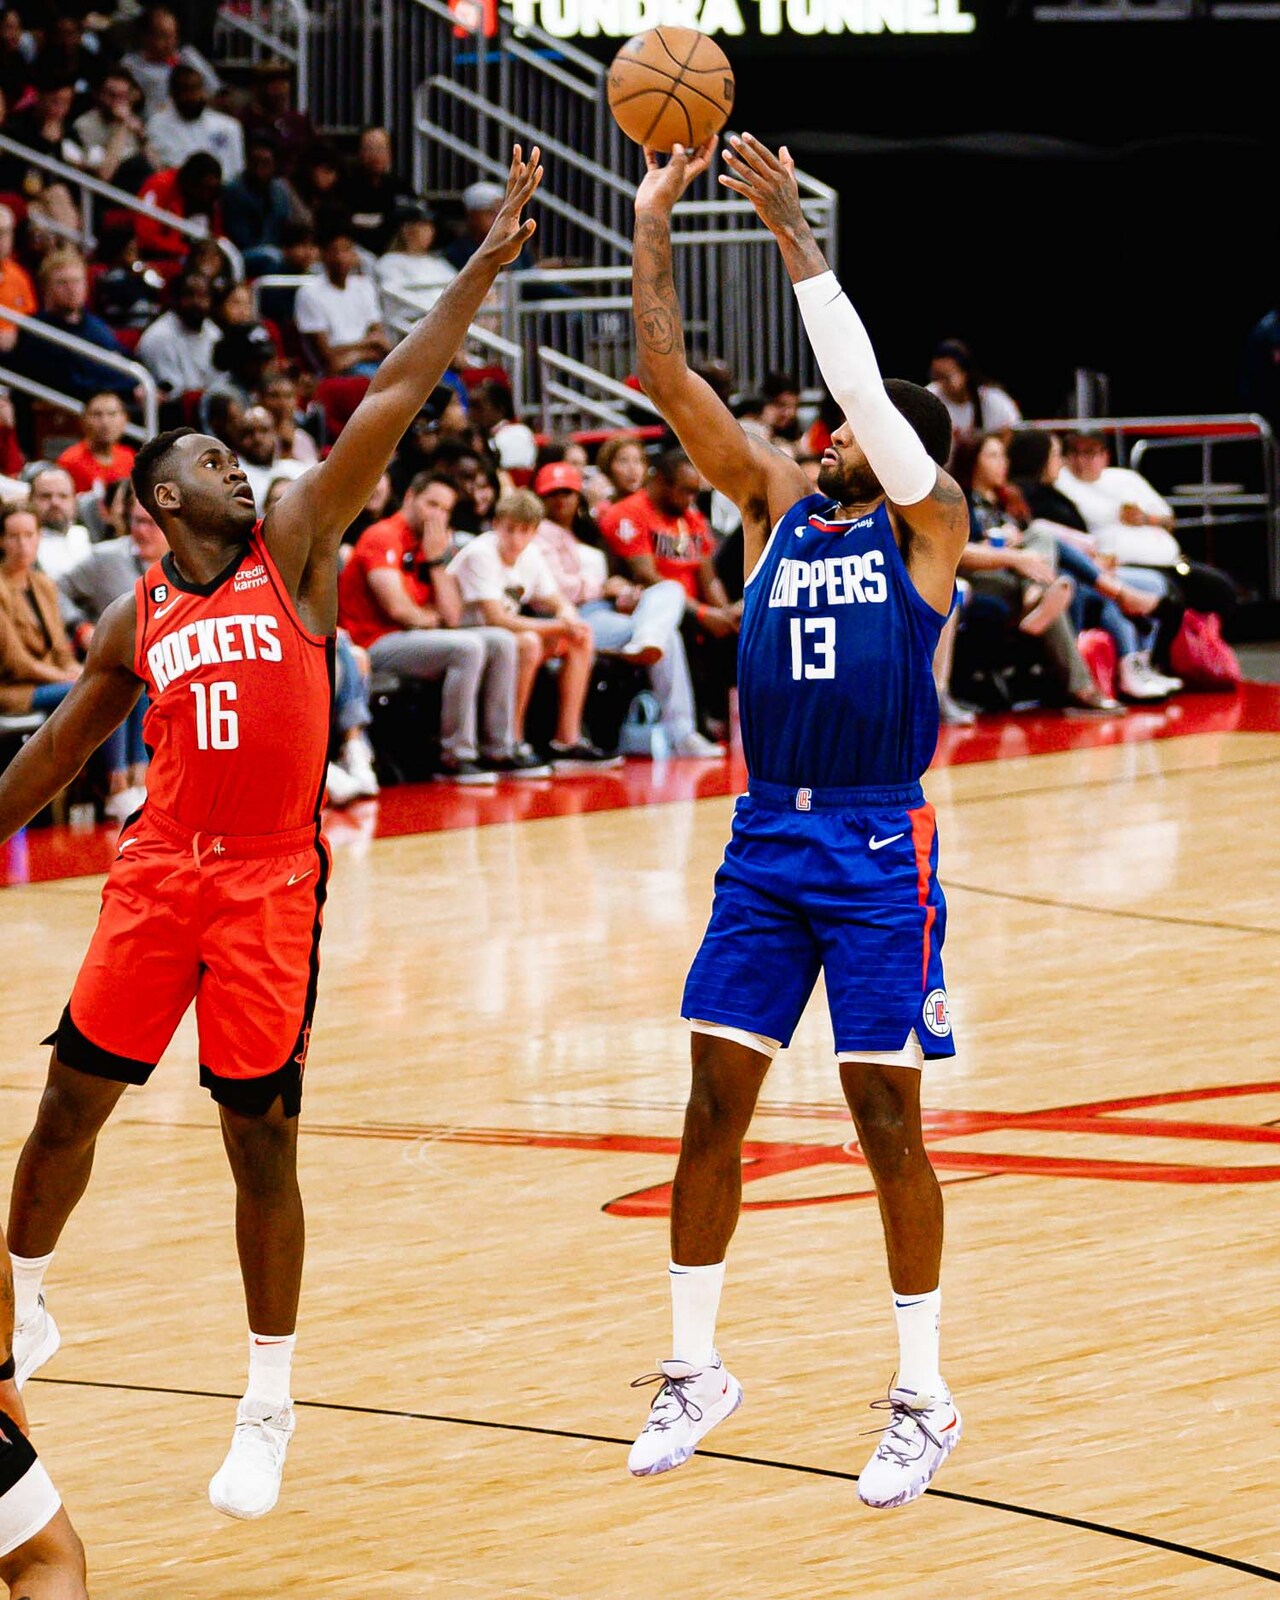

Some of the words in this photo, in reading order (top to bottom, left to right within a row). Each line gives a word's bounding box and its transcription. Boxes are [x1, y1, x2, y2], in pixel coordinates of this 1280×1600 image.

[507, 0, 746, 37] TUNDRA
[756, 0, 976, 35] TUNNEL
[234, 575, 268, 592] karma
[235, 565, 264, 580] credit
[154, 585, 167, 602] 6
[147, 615, 283, 693] ROCKETS
[790, 617, 836, 681] 13
[190, 681, 239, 750] 16
